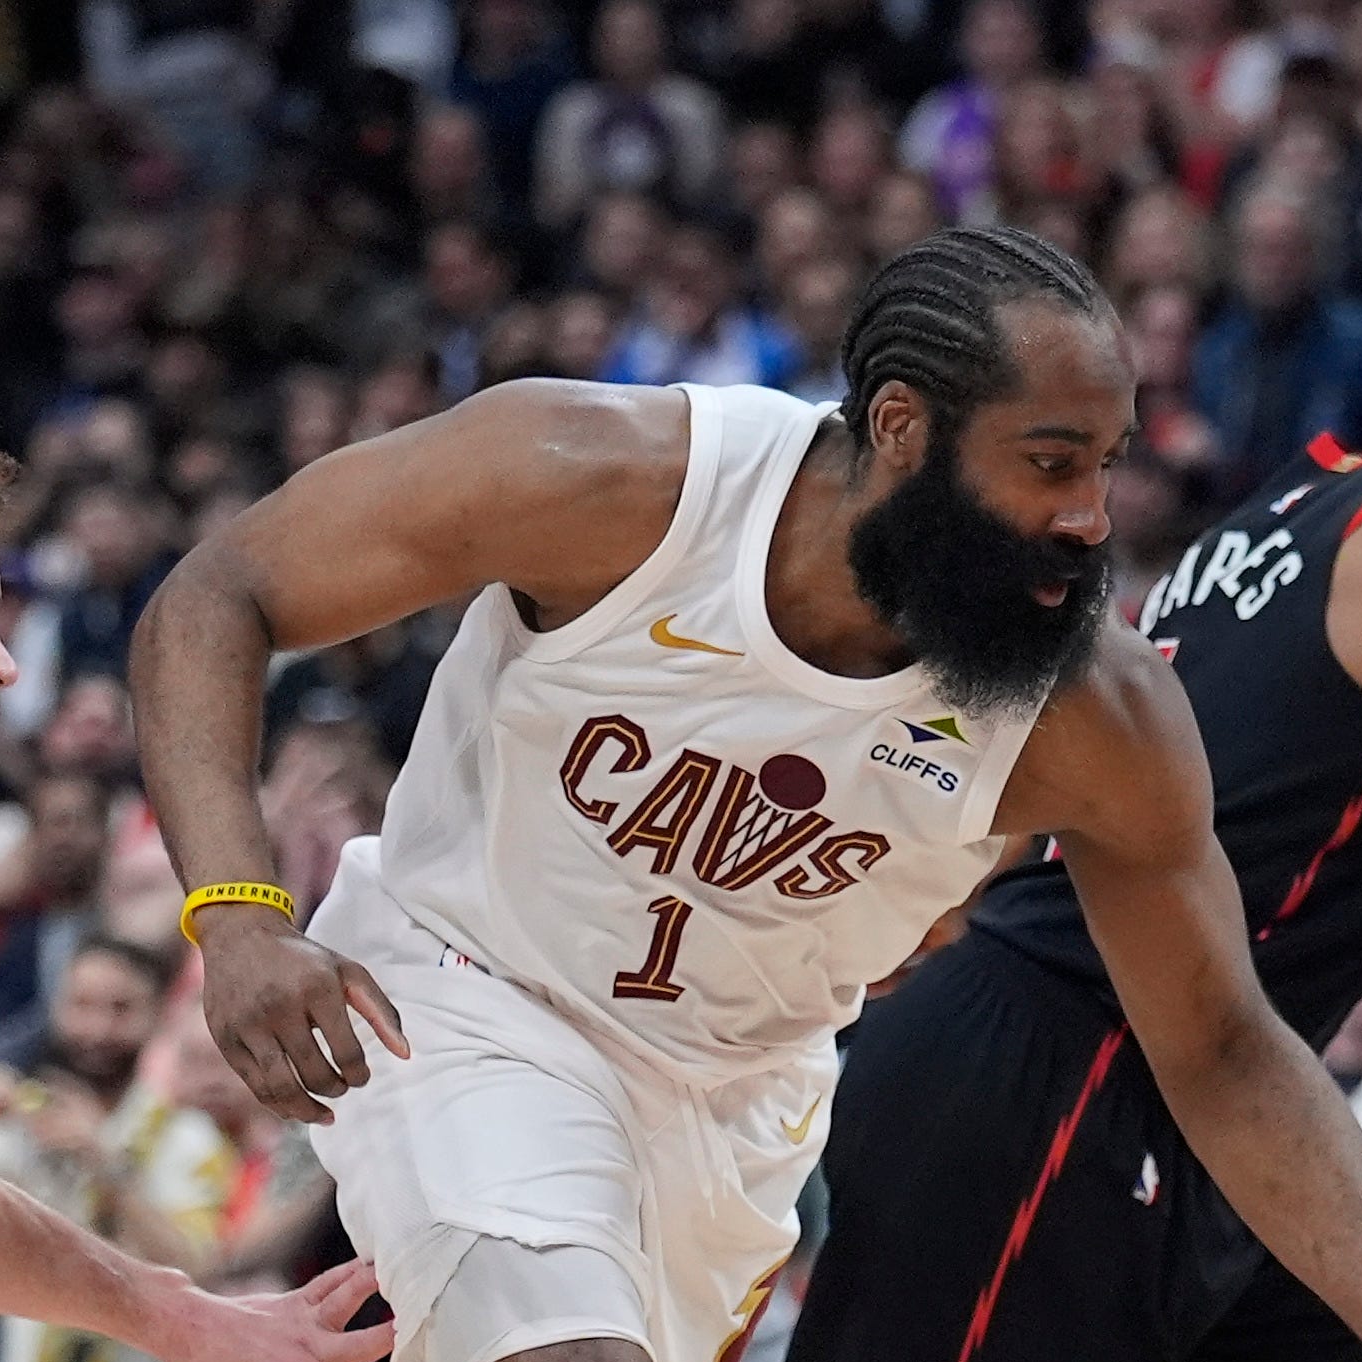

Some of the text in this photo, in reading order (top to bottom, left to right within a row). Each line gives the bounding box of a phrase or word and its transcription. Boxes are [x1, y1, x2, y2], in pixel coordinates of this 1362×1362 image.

[560, 713, 892, 900] CAVS
[869, 743, 959, 792] CLIFFS
[612, 894, 694, 1002] 1
